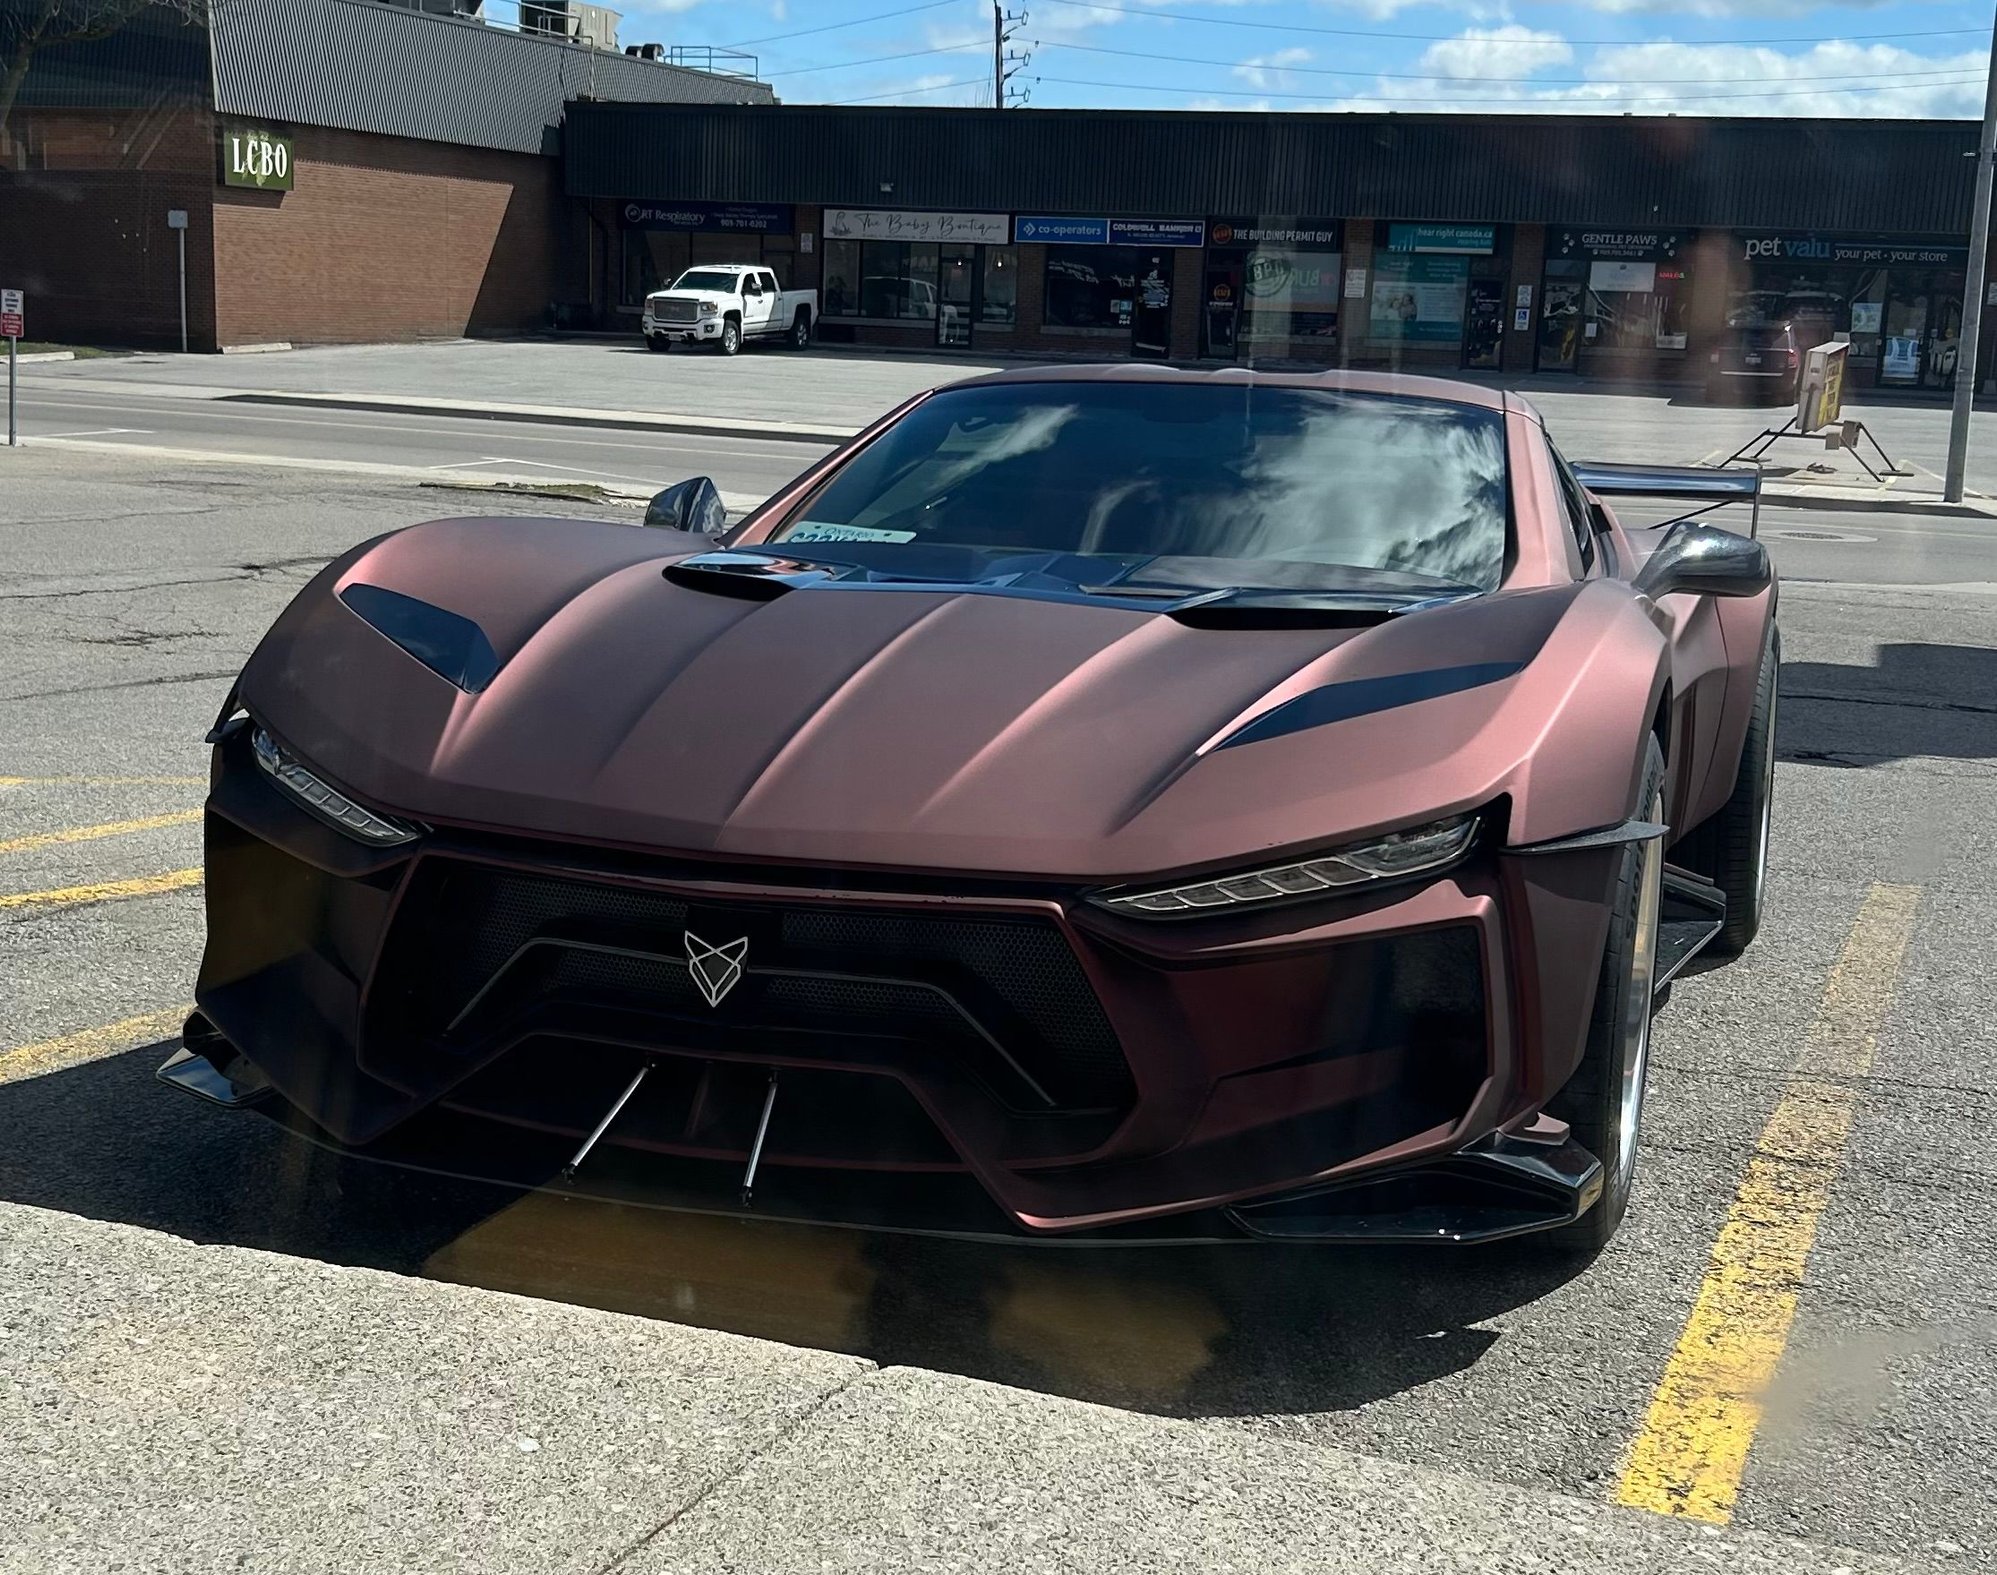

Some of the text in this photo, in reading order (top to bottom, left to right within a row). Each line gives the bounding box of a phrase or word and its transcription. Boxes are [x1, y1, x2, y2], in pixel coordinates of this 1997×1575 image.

[231, 136, 289, 178] LCBO
[641, 209, 653, 219] RT
[655, 209, 706, 225] Respiratory
[853, 212, 1002, 237] The Baby Boutique
[1038, 225, 1102, 237] co-operators
[1233, 229, 1248, 240] THE
[1248, 229, 1285, 241] BUILDING
[1286, 230, 1315, 242] PERMIT
[1316, 231, 1333, 242] GUY
[1417, 228, 1435, 237] hear
[1435, 228, 1455, 240] right
[1582, 233, 1658, 245] GENTLE PAWS
[1743, 237, 1831, 260] pet valu
[1835, 248, 1948, 263] your pet your store
